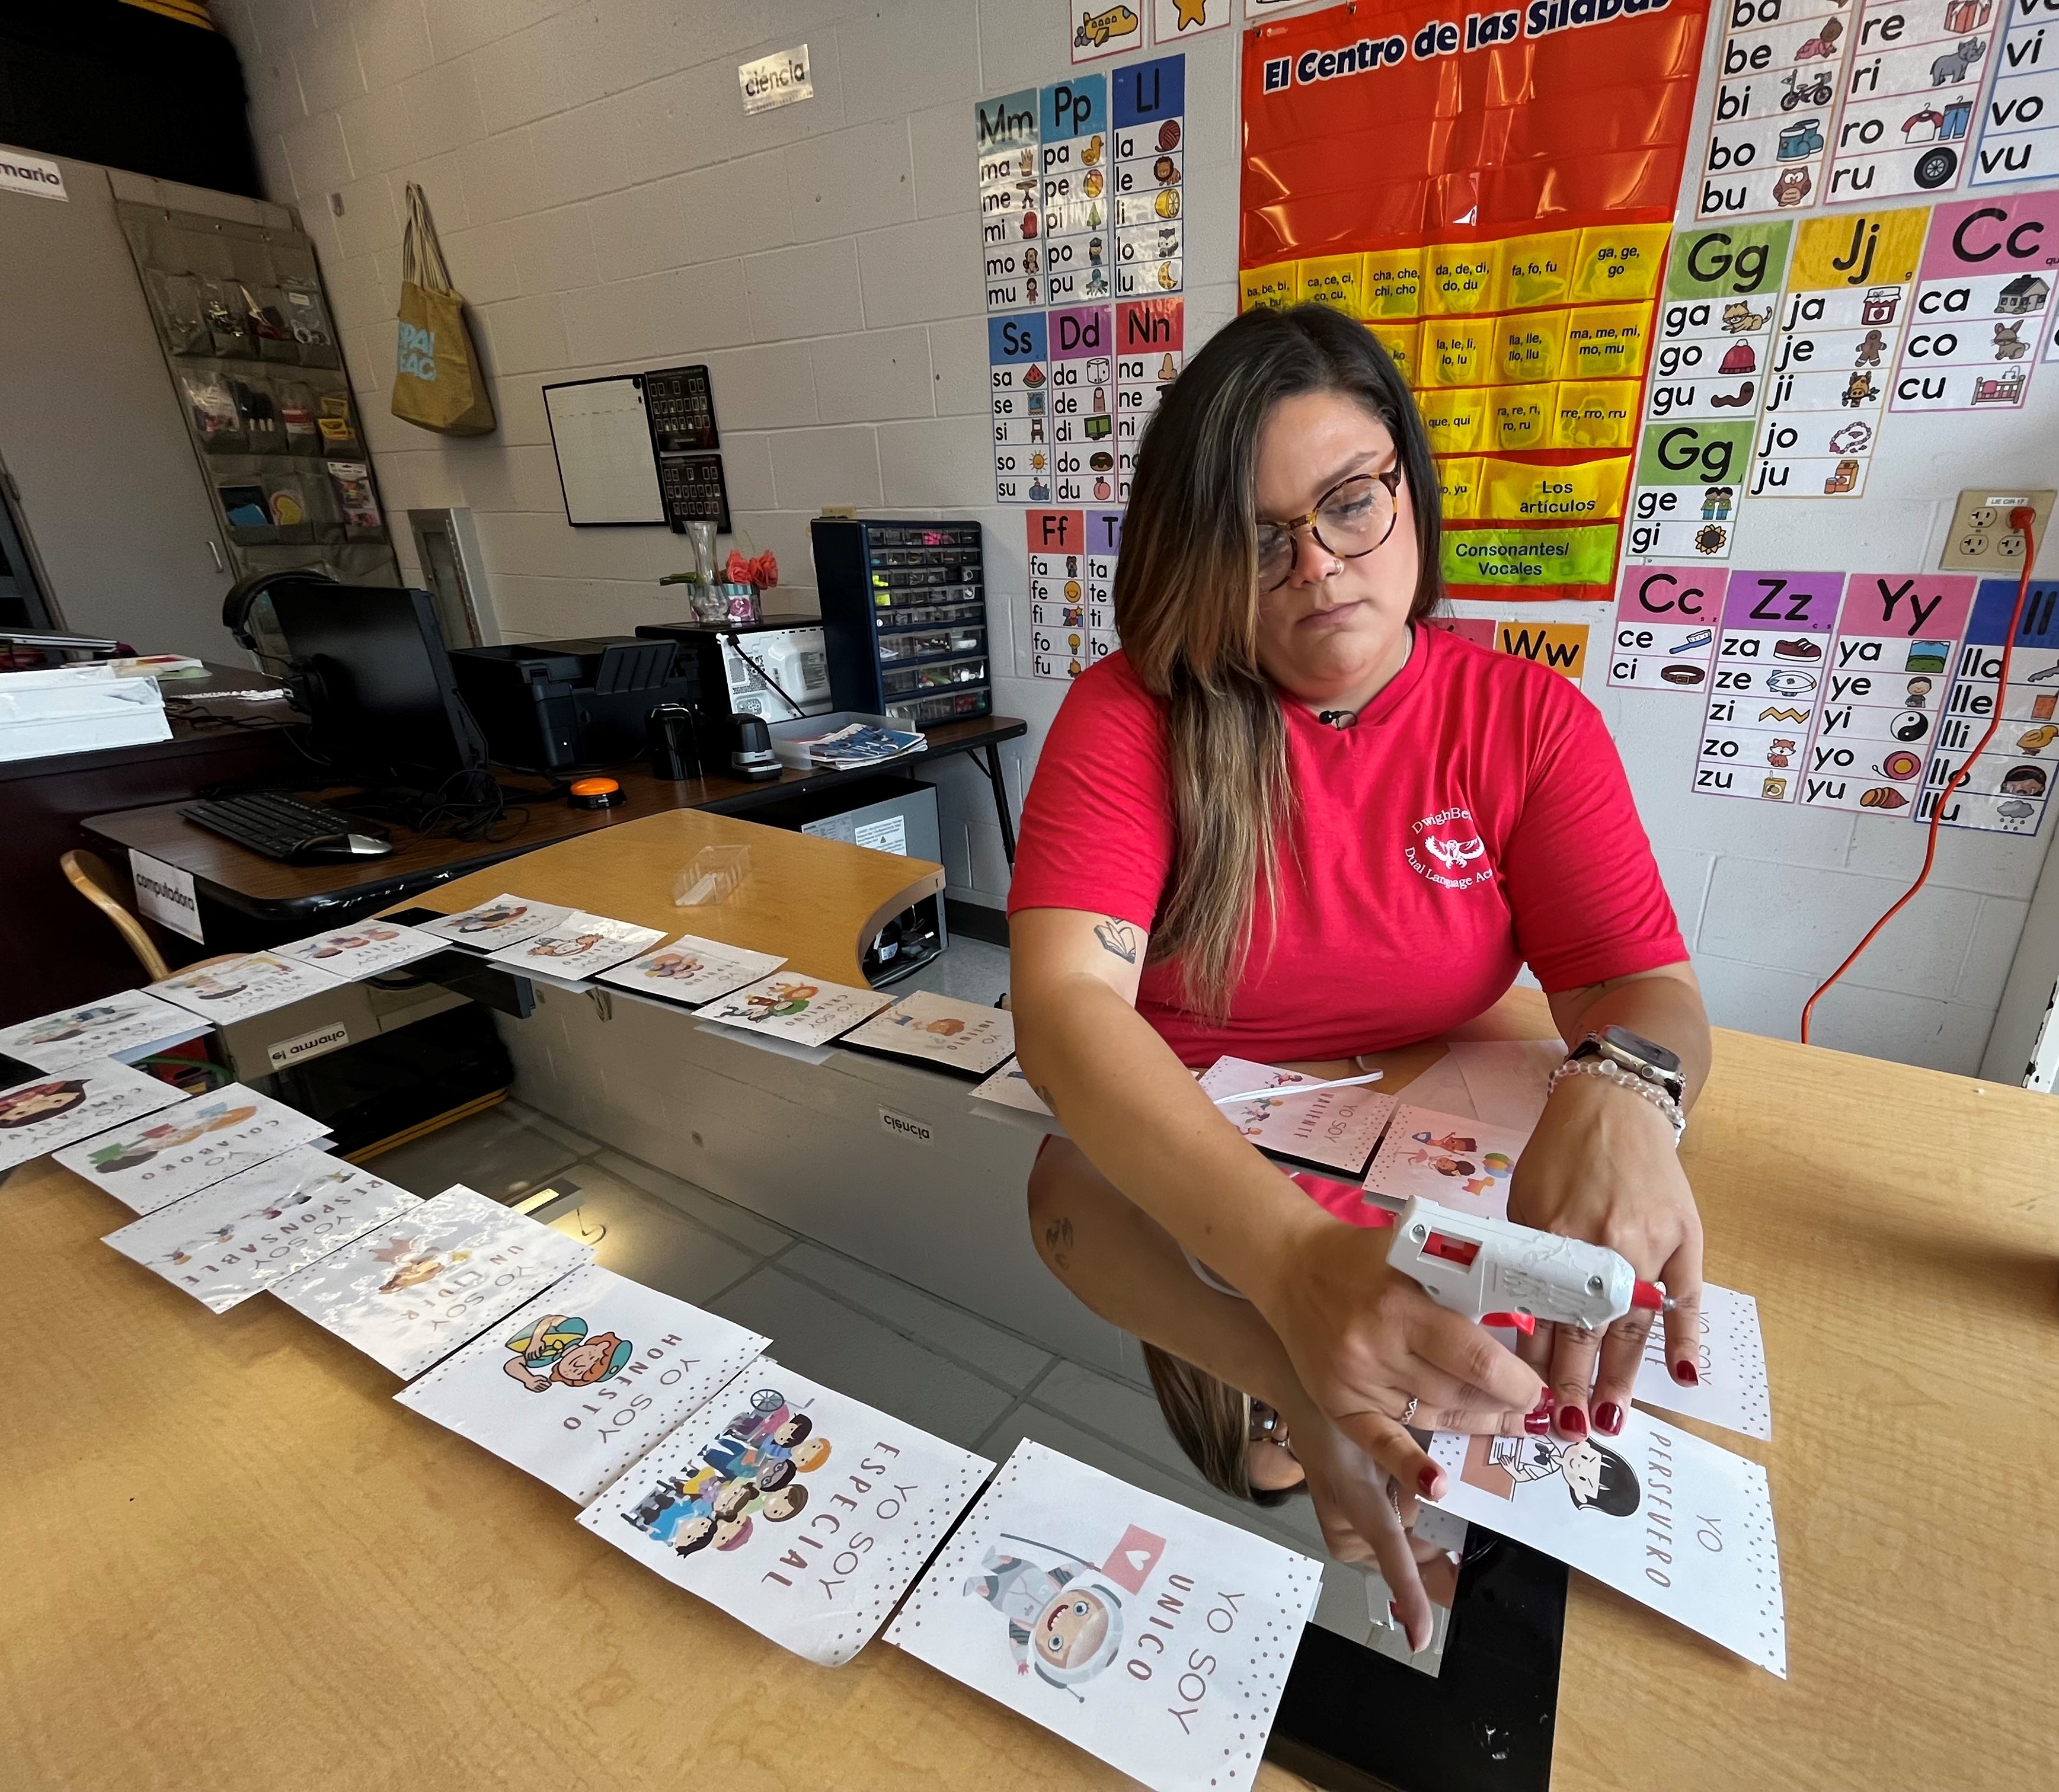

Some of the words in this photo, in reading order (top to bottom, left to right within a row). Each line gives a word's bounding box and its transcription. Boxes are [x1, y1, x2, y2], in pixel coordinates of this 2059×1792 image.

[1861, 14, 1905, 46] re
[1265, 59, 1290, 91] El
[1298, 38, 1405, 82] Centro
[1414, 23, 1457, 57] de
[1466, 14, 1518, 49] las
[1724, 39, 1772, 75] be
[2006, 29, 2045, 68] vi
[1851, 56, 1882, 95] ri
[1136, 68, 1160, 113] Ll
[1716, 85, 1751, 121] bi
[980, 103, 1034, 144] Mm
[1054, 86, 1092, 136] Pp
[1992, 96, 2044, 126] vo
[1115, 132, 1133, 159] la
[1840, 119, 1884, 148] ro
[1044, 145, 1069, 174] pa
[1708, 136, 1756, 171] bo
[1980, 144, 2032, 174] vu
[981, 160, 1011, 181] ma
[1115, 166, 1133, 193] le
[1831, 165, 1875, 193] ru
[983, 192, 1011, 213] me
[1044, 178, 1069, 206] pe
[1701, 180, 1747, 214] bu
[984, 218, 1006, 242] mi
[1952, 207, 2045, 263] Cc
[1048, 245, 1073, 273] po
[1117, 236, 1134, 261] lo
[1597, 248, 1617, 261] ga,
[1620, 247, 1640, 260] ge,
[1832, 218, 1880, 285] Jj
[986, 257, 1015, 276] mo
[1373, 270, 1395, 281] cha,
[1397, 268, 1421, 280] che,
[1435, 264, 1451, 277] da,
[1455, 263, 1472, 276] de,
[1475, 261, 1489, 274] di,
[1512, 264, 1525, 277] fa,
[1528, 263, 1542, 275] fo,
[1545, 261, 1558, 273] fu
[1607, 265, 1625, 278] go
[1687, 232, 1769, 293] Gg
[1050, 275, 1073, 302] pu
[1117, 268, 1133, 293] lu
[1374, 285, 1393, 297] chi,
[1395, 284, 1416, 295] cho
[1443, 280, 1460, 292] do,
[1463, 279, 1478, 290] du
[988, 286, 1016, 305] mu
[1919, 288, 1971, 314] ca
[1665, 305, 1710, 337] ga
[1782, 293, 1825, 332] ja
[1003, 322, 1032, 356] Ss
[1060, 312, 1100, 351] Dd
[1128, 308, 1170, 345] Nn
[1569, 329, 1592, 340] ma,
[1596, 328, 1617, 340] me,
[1622, 325, 1640, 338] mi,
[1579, 346, 1601, 357] mo,
[1604, 345, 1625, 354] mu
[1773, 335, 1814, 373] je
[1908, 334, 1958, 358] co
[1118, 361, 1143, 379] na
[1659, 345, 1703, 376] go
[993, 372, 1012, 387] sa
[1053, 363, 1077, 386] da
[1118, 391, 1142, 408] ne
[1652, 386, 1695, 416] gu
[1766, 374, 1794, 411] ji
[1898, 377, 1946, 400] cu
[994, 399, 1012, 414] se
[1054, 392, 1078, 414] de
[995, 422, 1008, 441] si
[1056, 420, 1072, 442] di
[1758, 422, 1798, 457] jo
[997, 456, 1015, 471] so
[1057, 451, 1080, 473] do
[1658, 427, 1734, 483] Gg
[998, 482, 1016, 497] su
[1058, 478, 1080, 500] du
[1542, 480, 1573, 494] Los
[1750, 460, 1790, 495] ju
[1520, 499, 1596, 513] artículos
[1637, 492, 1677, 519] ge
[1042, 516, 1069, 546] Ff
[1632, 522, 1661, 554] gi
[1456, 542, 1569, 557] Consonantes/
[1030, 555, 1048, 575] fa
[1089, 558, 1107, 578] ta
[1478, 561, 1542, 575] Vocales
[1031, 580, 1048, 600] fe
[1089, 583, 1107, 603] te
[1639, 573, 1704, 615] Cc
[1749, 578, 1813, 621] Zz
[1032, 604, 1043, 623] fi
[1089, 609, 1101, 628] ti
[1877, 578, 1942, 636] Yy
[1033, 632, 1050, 651] fo
[1091, 637, 1108, 656] to
[1618, 630, 1654, 648] ce
[1721, 638, 1760, 657] za
[1034, 655, 1051, 675] fu
[1839, 641, 1882, 668] ya
[1613, 658, 1638, 680] ci
[1715, 671, 1751, 690] ze
[1831, 676, 1871, 705] ye
[1709, 699, 1735, 722] zi
[1823, 706, 1852, 735] yi
[1703, 739, 1739, 757] zo
[1814, 746, 1855, 772] yo
[1697, 770, 1733, 789] zu
[1806, 779, 1846, 803] yu
[1405, 847, 1425, 873] Dual
[1425, 869, 1473, 889] Language
[136, 873, 195, 911] computadora
[785, 994, 848, 1026] CREATIVO
[808, 1013, 835, 1029] SOY
[837, 1003, 858, 1012] YO
[982, 1035, 1002, 1044] YO
[1293, 1093, 1334, 1138] VALIENTE
[1339, 1105, 1358, 1117] YO
[1324, 1121, 1347, 1143] SOY
[141, 1119, 280, 1180] COLABORO
[181, 1179, 384, 1285] RESPONSABLE
[314, 1215, 353, 1235] YO
[255, 1237, 309, 1270] SOY
[563, 1333, 683, 1430] HONESTO
[660, 1357, 701, 1385] YO
[598, 1393, 653, 1445] SOY
[761, 1441, 901, 1587] ESPECIAL
[876, 1482, 918, 1520] YO
[1645, 1431, 1673, 1588] PERSEVERO
[1696, 1514, 1723, 1552] YO
[817, 1531, 875, 1601] SOY
[1207, 1590, 1245, 1635] YO
[1127, 1574, 1194, 1682] UNICO
[1168, 1647, 1218, 1736] SOY
